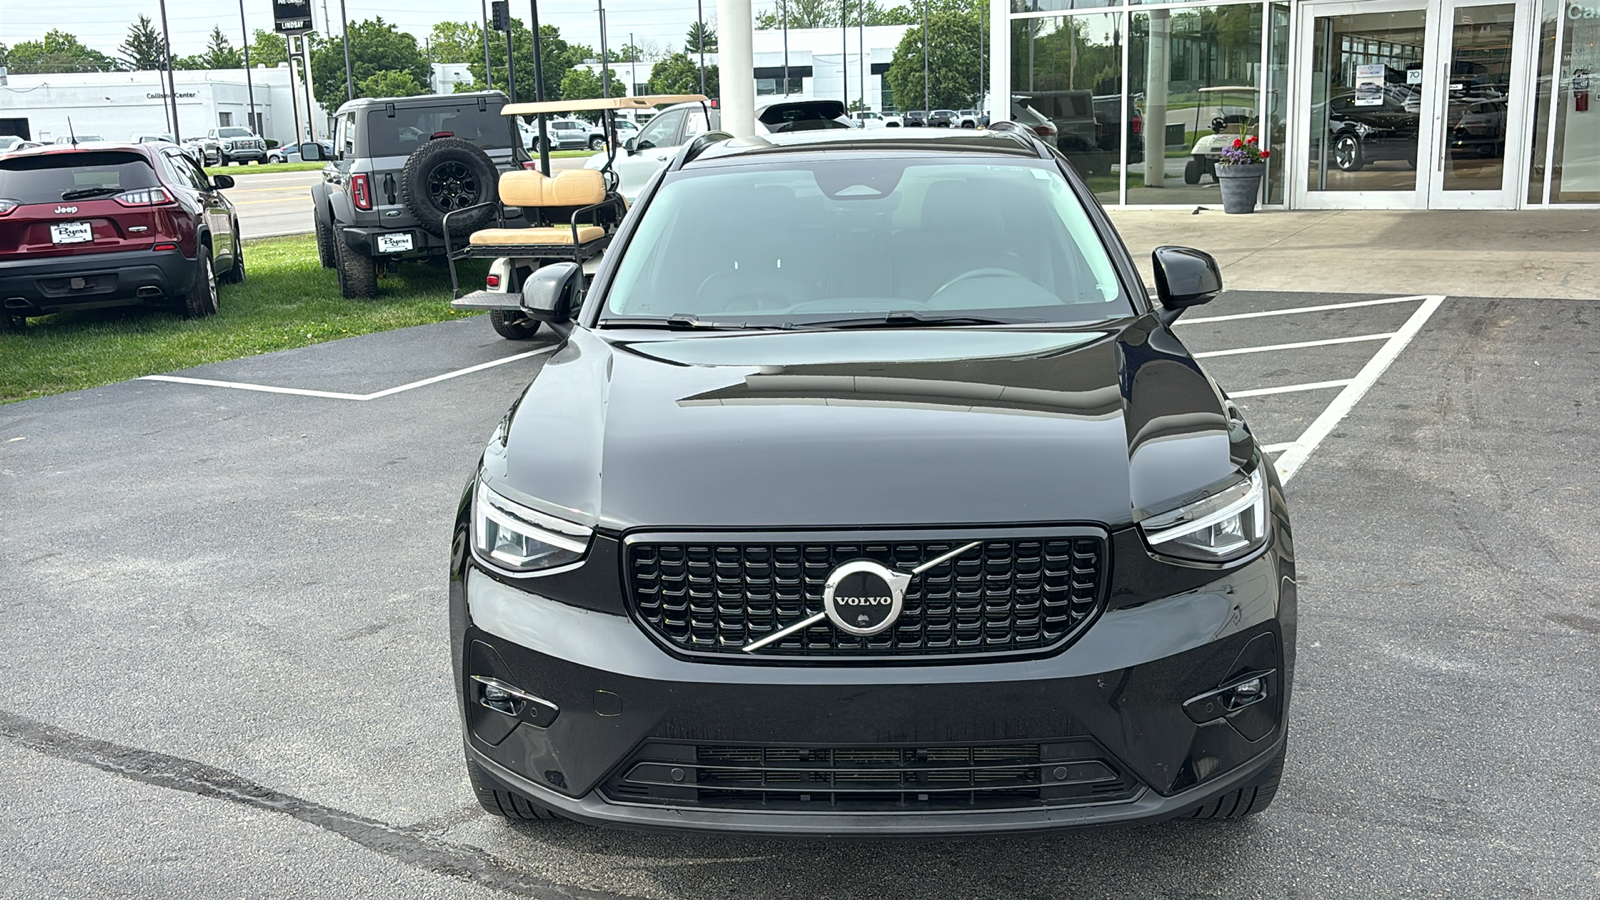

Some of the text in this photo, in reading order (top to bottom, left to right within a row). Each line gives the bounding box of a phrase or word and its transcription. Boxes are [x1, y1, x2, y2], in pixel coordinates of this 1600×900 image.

[1567, 4, 1600, 19] Ca
[282, 21, 304, 29] LINDSAY
[835, 596, 891, 606] VOLVO
